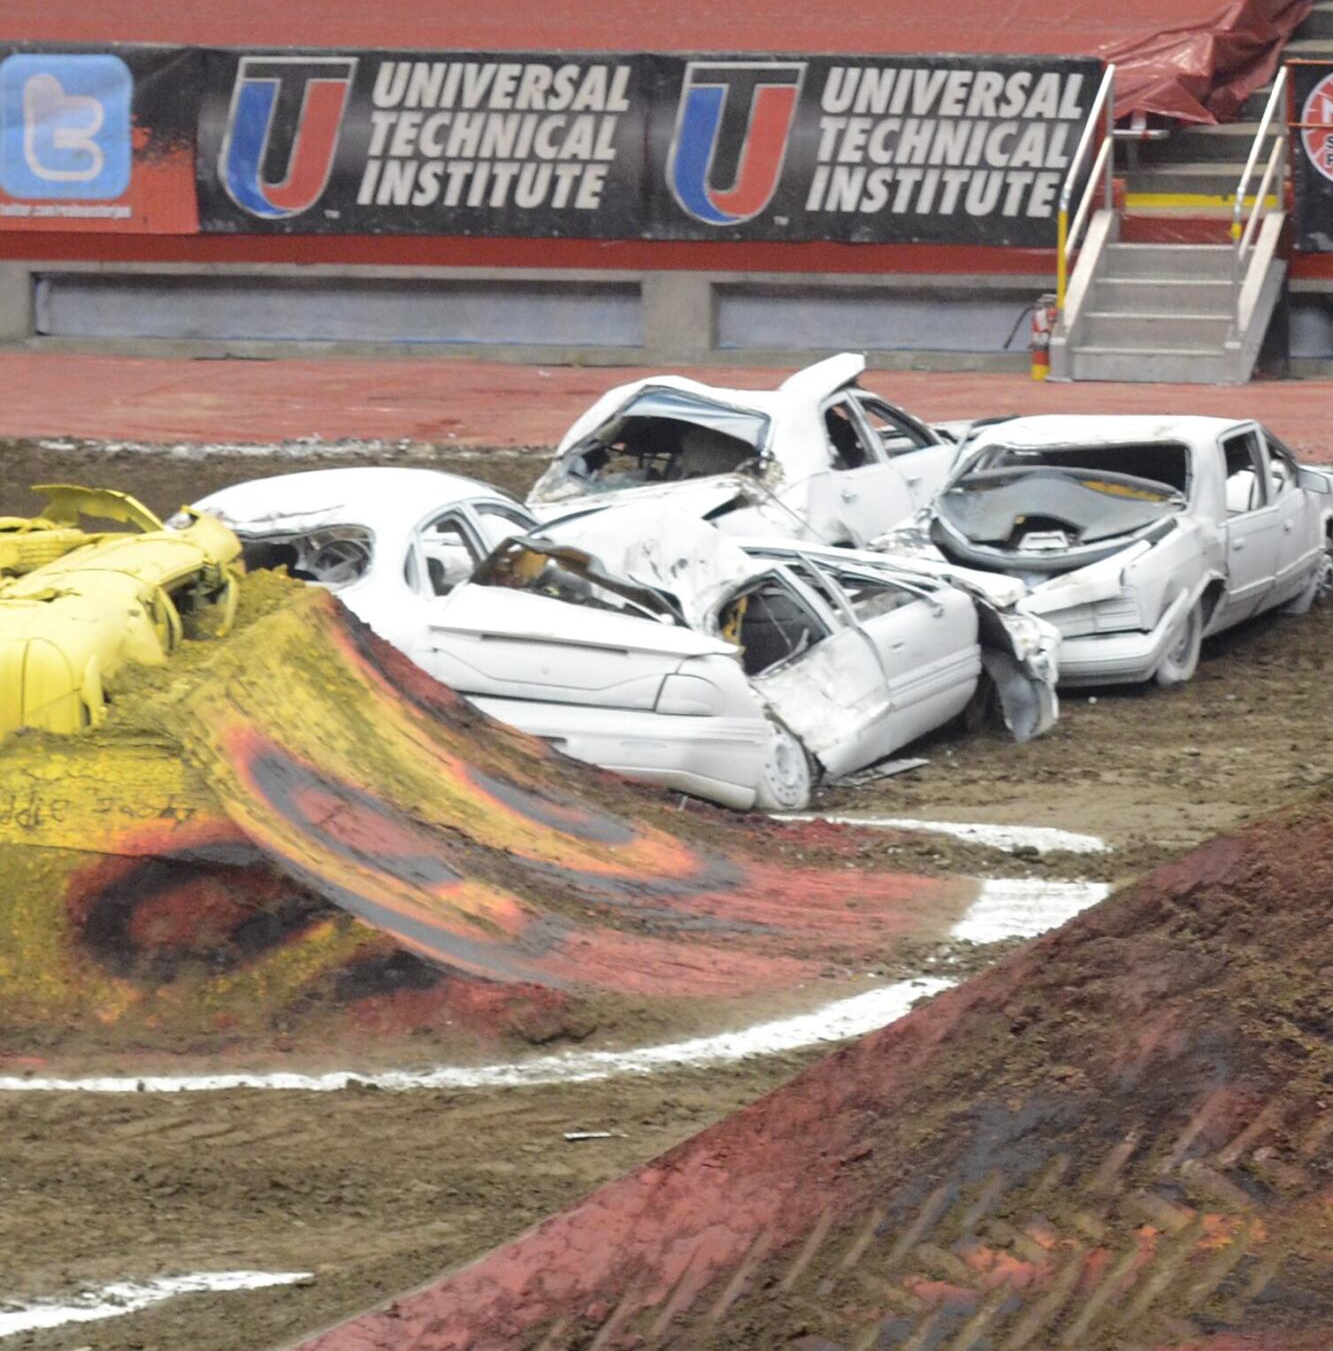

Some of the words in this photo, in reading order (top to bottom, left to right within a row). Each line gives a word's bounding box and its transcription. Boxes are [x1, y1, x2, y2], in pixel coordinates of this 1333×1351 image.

[373, 62, 630, 112] UNIVERSAL
[821, 67, 1085, 120] UNIVERSAL
[370, 112, 618, 161] TECHNICAL
[815, 116, 1072, 169] TECHNICAL
[357, 161, 608, 210] INSTITUTE
[805, 167, 1061, 218] INSTITUTE
